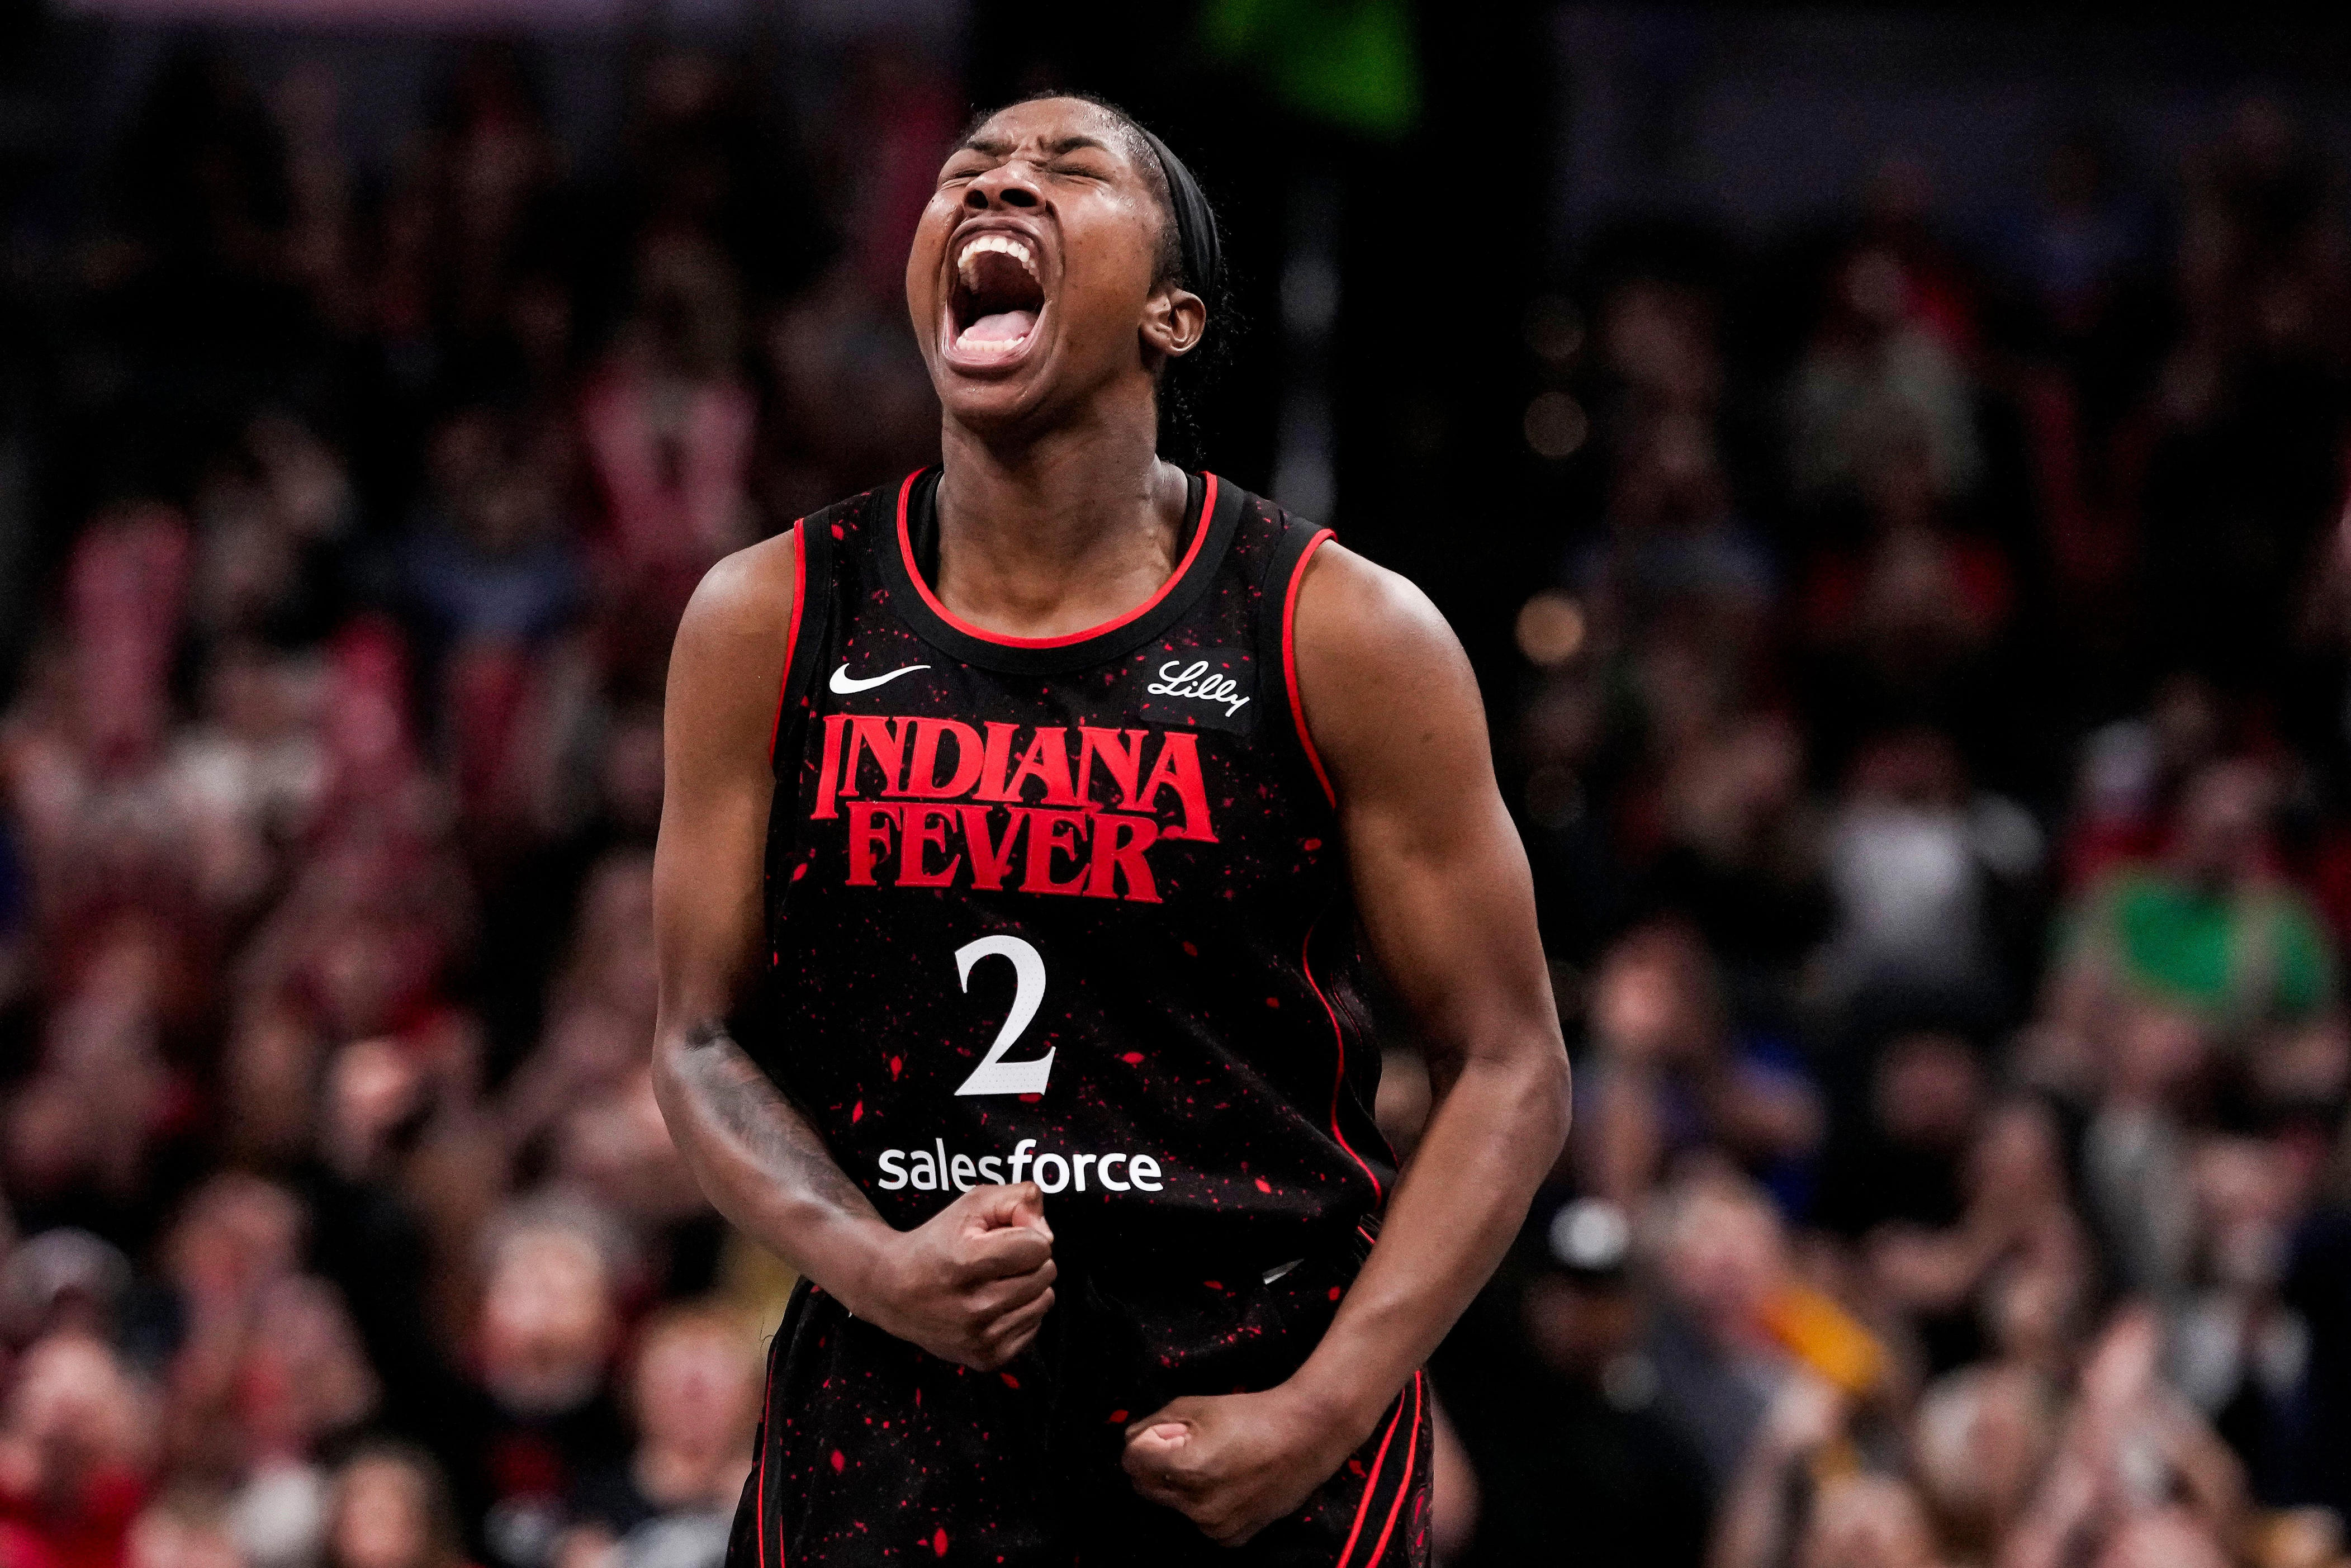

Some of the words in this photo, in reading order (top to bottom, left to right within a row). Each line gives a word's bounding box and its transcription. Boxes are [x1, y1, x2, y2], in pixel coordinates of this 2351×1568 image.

[1147, 660, 1250, 717] Lilly
[810, 714, 1219, 843] INDIANA
[845, 800, 1164, 904] FEVER
[954, 935, 1057, 1097] 2
[878, 1138, 1164, 1193] salesforce
